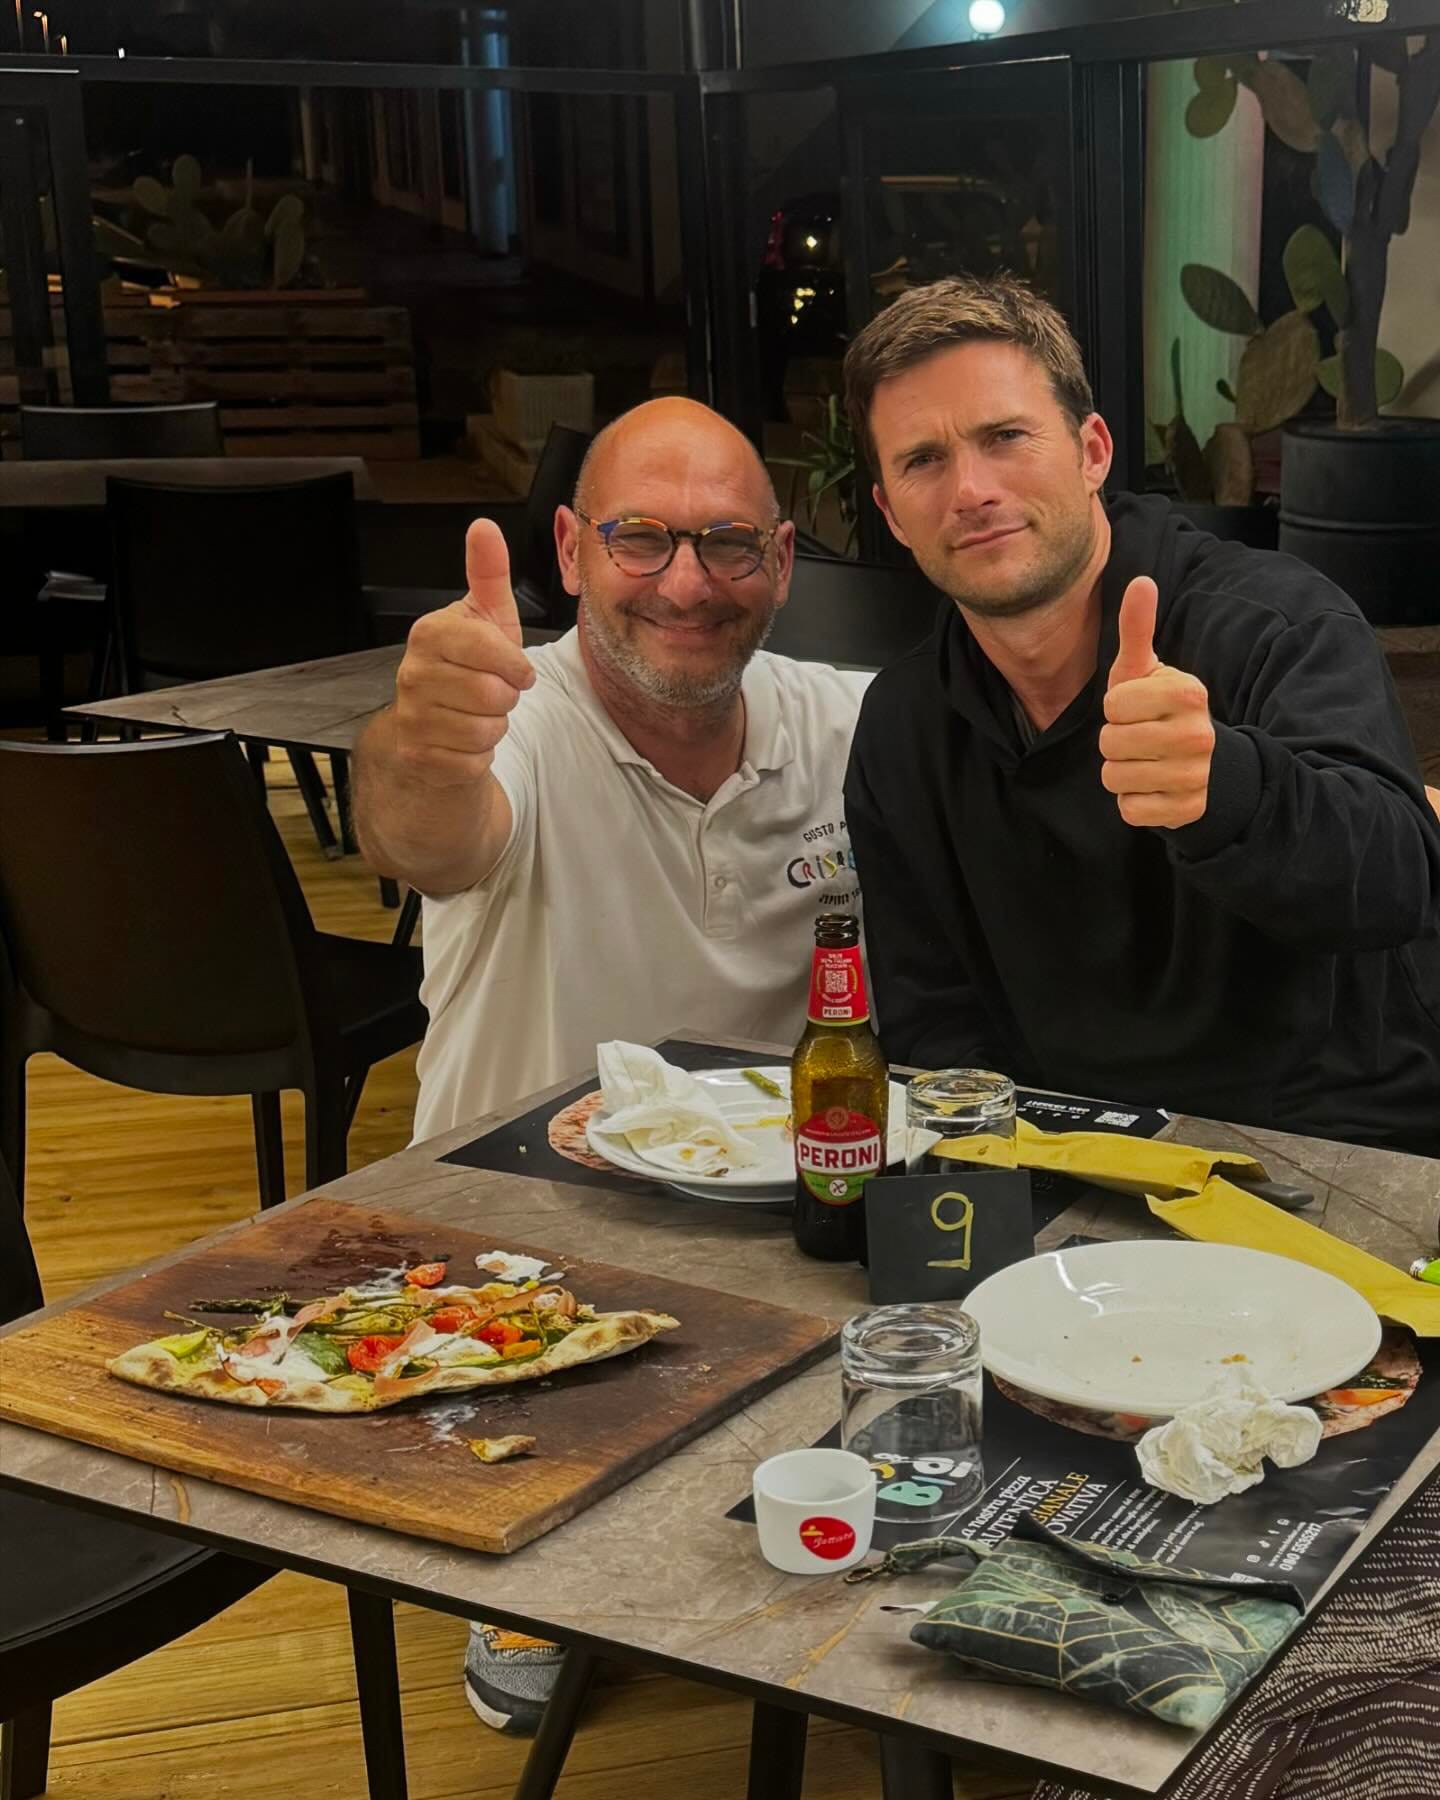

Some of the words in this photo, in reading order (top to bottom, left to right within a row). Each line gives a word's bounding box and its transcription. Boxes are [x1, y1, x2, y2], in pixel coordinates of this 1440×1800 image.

[803, 822, 835, 843] GUSTO
[799, 1142, 879, 1169] PERONI
[926, 1191, 974, 1271] 9
[968, 1498, 1008, 1528] nostra
[999, 1475, 1032, 1500] pizza
[1029, 1471, 1090, 1525] GIANALE
[1045, 1482, 1109, 1534] OVATIVA
